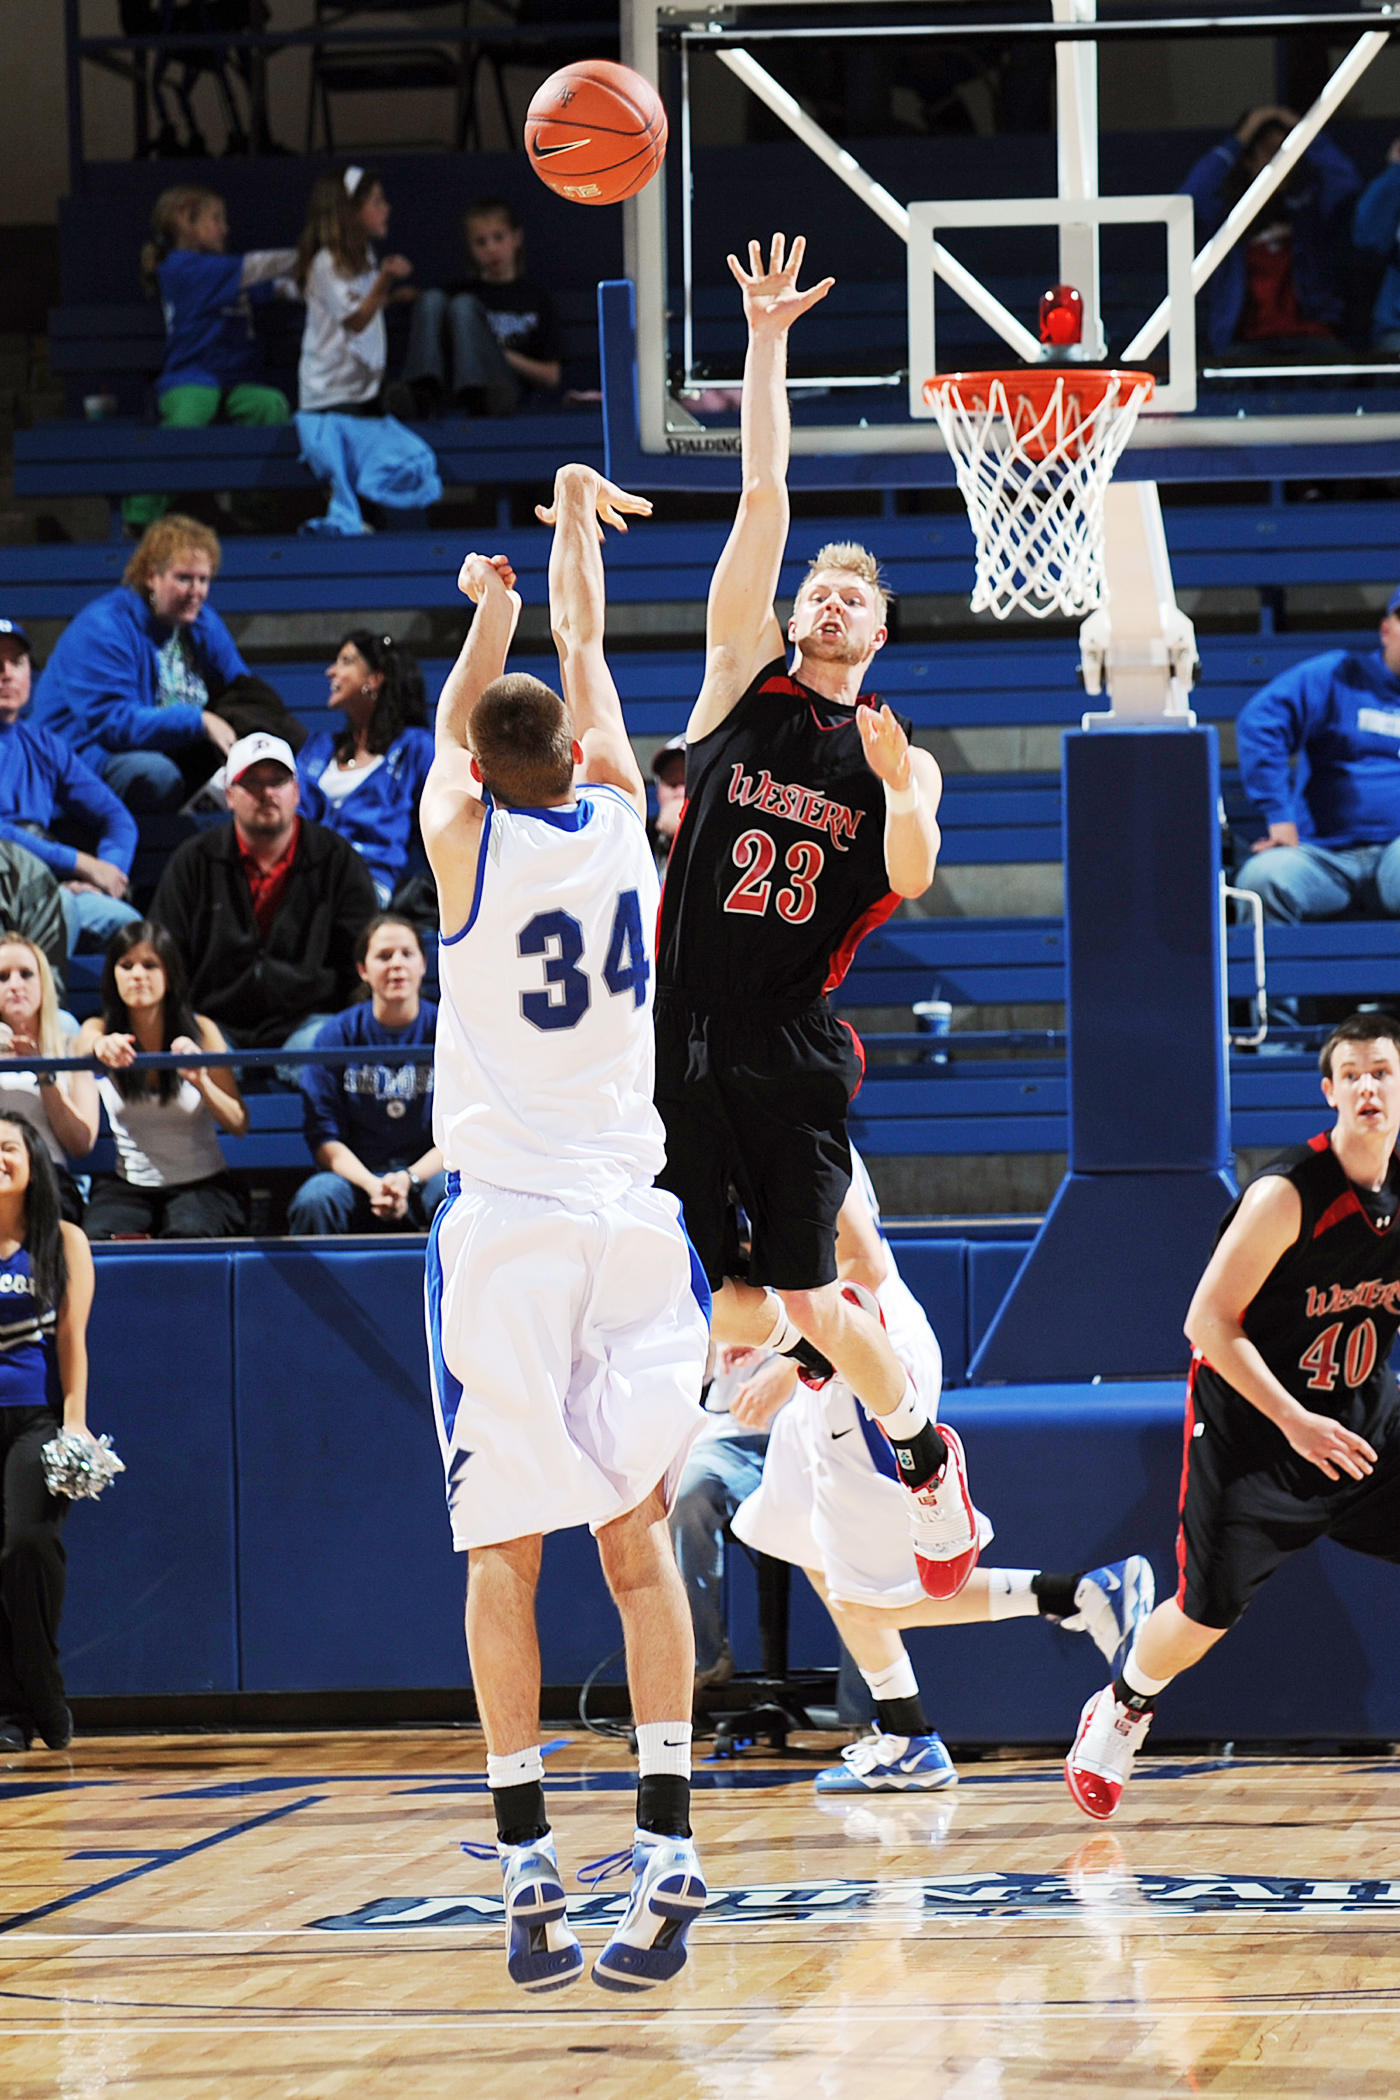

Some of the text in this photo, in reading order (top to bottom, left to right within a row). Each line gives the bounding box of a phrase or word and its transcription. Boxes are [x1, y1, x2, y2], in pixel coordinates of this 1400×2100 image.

[728, 763, 866, 851] WESTERN
[724, 829, 825, 924] 23
[515, 886, 650, 1033] 34
[1298, 1317, 1378, 1391] 40
